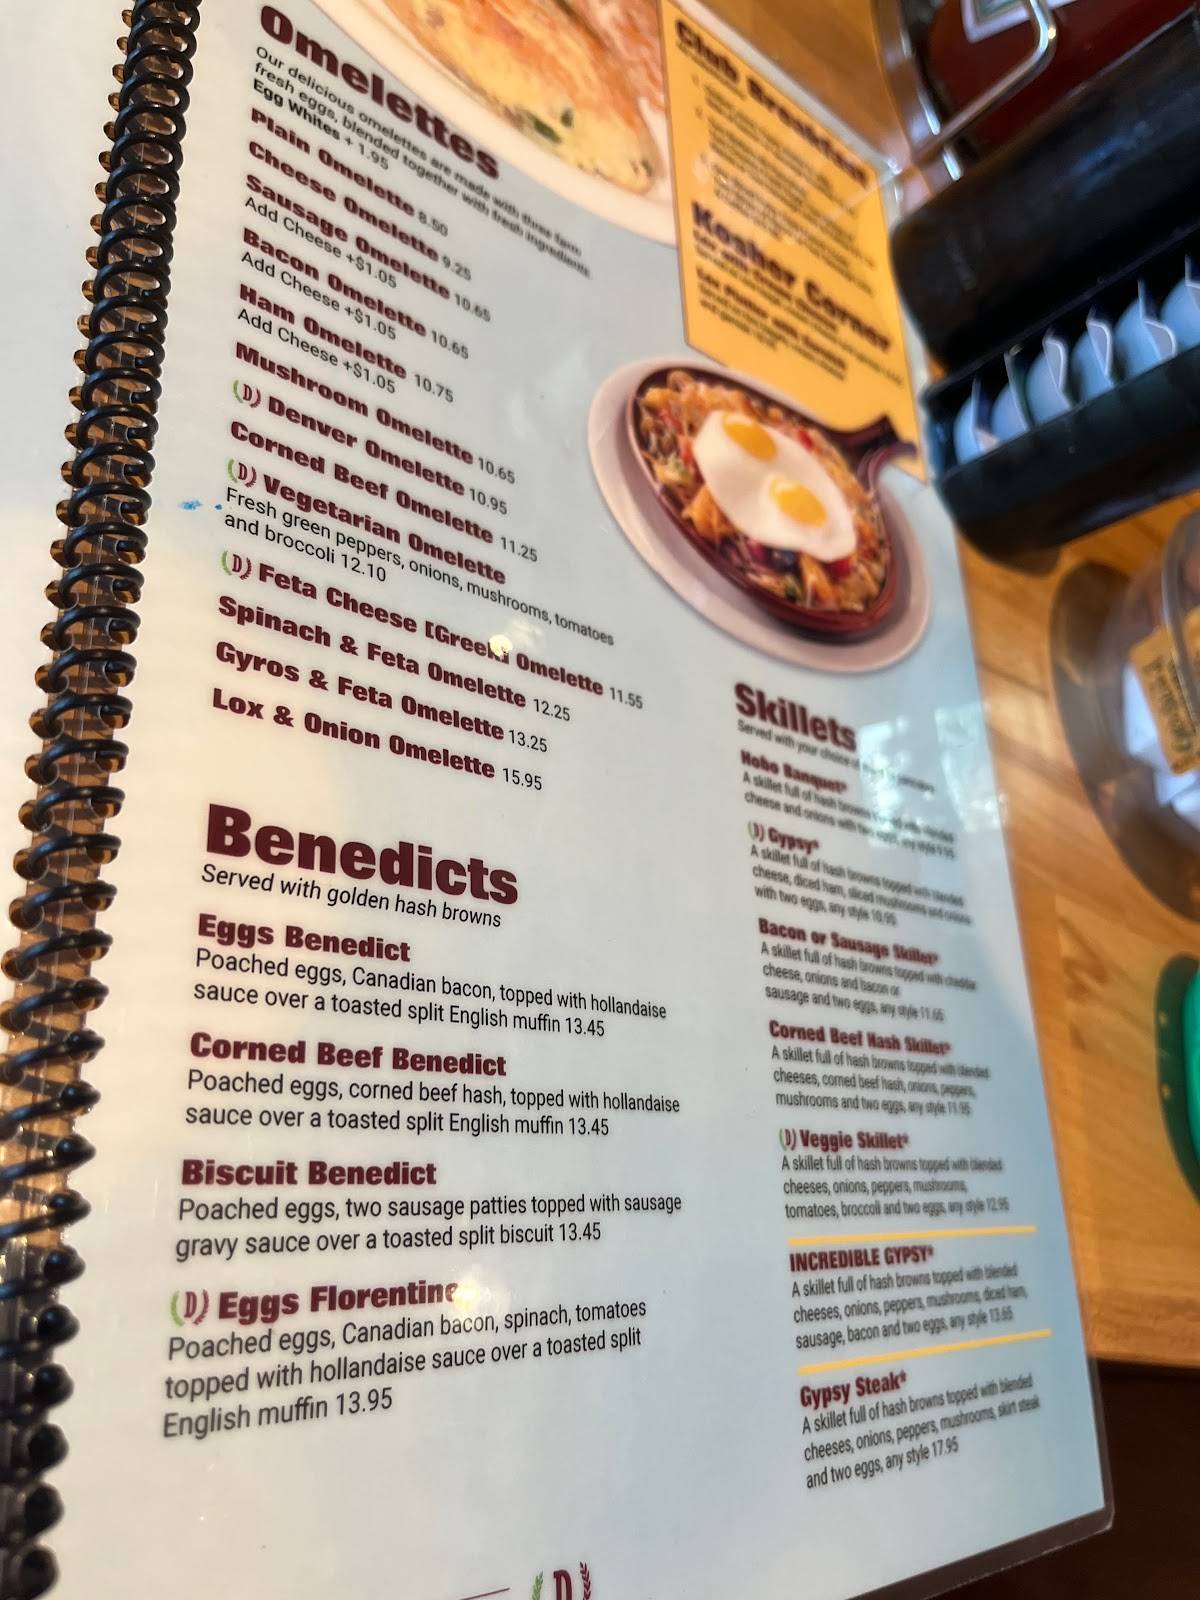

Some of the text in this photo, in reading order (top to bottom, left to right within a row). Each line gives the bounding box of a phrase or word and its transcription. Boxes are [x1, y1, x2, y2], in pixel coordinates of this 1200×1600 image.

[253, 77, 388, 170] Egg Whites 1.95
[255, 46, 427, 161] Our delicious omelettes
[255, 61, 294, 94] fresh
[298, 91, 337, 123] eggs,
[342, 114, 399, 159] blended
[260, 4, 500, 180] Omelettes
[251, 107, 310, 154] Plain
[317, 148, 414, 216] Omelette
[244, 196, 396, 288] Add Cheese +$1.05
[245, 173, 490, 322] Sausage Omelette 10.65
[248, 140, 471, 281] Cheese Omelette 9.25
[243, 226, 468, 359] Bacon Omelette 10.65
[239, 282, 453, 403] Ham Omelette 10.75
[235, 341, 515, 484] Mushroom Omelette 10.65
[230, 420, 537, 562] Corned Beef Omelette 11.25
[268, 395, 507, 515] Denver Omelette 10.95
[224, 513, 386, 582] and broccoli 12.10
[226, 486, 551, 624] Fresh green peppers, onions, mushrooms,
[262, 473, 505, 584] Vegetarian Omelette
[218, 595, 570, 721] Spinach & Feta Omelette 12.25
[258, 562, 603, 695] Feta Cheese Omelette
[215, 641, 547, 752] Gyros & Feta Omelette 13.25
[735, 682, 857, 752] Skillets
[212, 687, 542, 790] Lox & Onion Omelette 15.95
[206, 803, 519, 905] Benedicts
[201, 863, 501, 927] Served with golden hash browns
[757, 917, 807, 942] Bacon
[810, 930, 827, 945] or
[197, 912, 410, 962] Eggs Benedict
[193, 983, 604, 1037] sauce over a toasted split English muffin 13.45
[195, 947, 666, 1019] Poached eggs, Canadian bacon, topped with hollandaise
[189, 1031, 506, 1076] Corned Beef Benedict
[768, 1019, 863, 1046] Corned Beef
[181, 1158, 436, 1185] Biscuit Benedict
[799, 1129, 853, 1153] Veggie
[178, 1192, 681, 1224] Poached eggs, two sausage patties topped with sausage
[789, 1247, 880, 1272] INCREDIBLE
[168, 1300, 646, 1360] Poached eggs, Canadian bacon, spinach, tomatoes
[217, 1291, 299, 1326] Eggs
[164, 1326, 641, 1403] topped with hollandaise sauce over a toasted split
[799, 1383, 850, 1410] Gypsy
[162, 1386, 392, 1440] English muffin 13.95
[801, 1397, 907, 1434] A skillet full of hash
[803, 1419, 939, 1462] cheeses, onions, peppers,
[806, 1435, 959, 1489] and two eggs, any style 17.95
